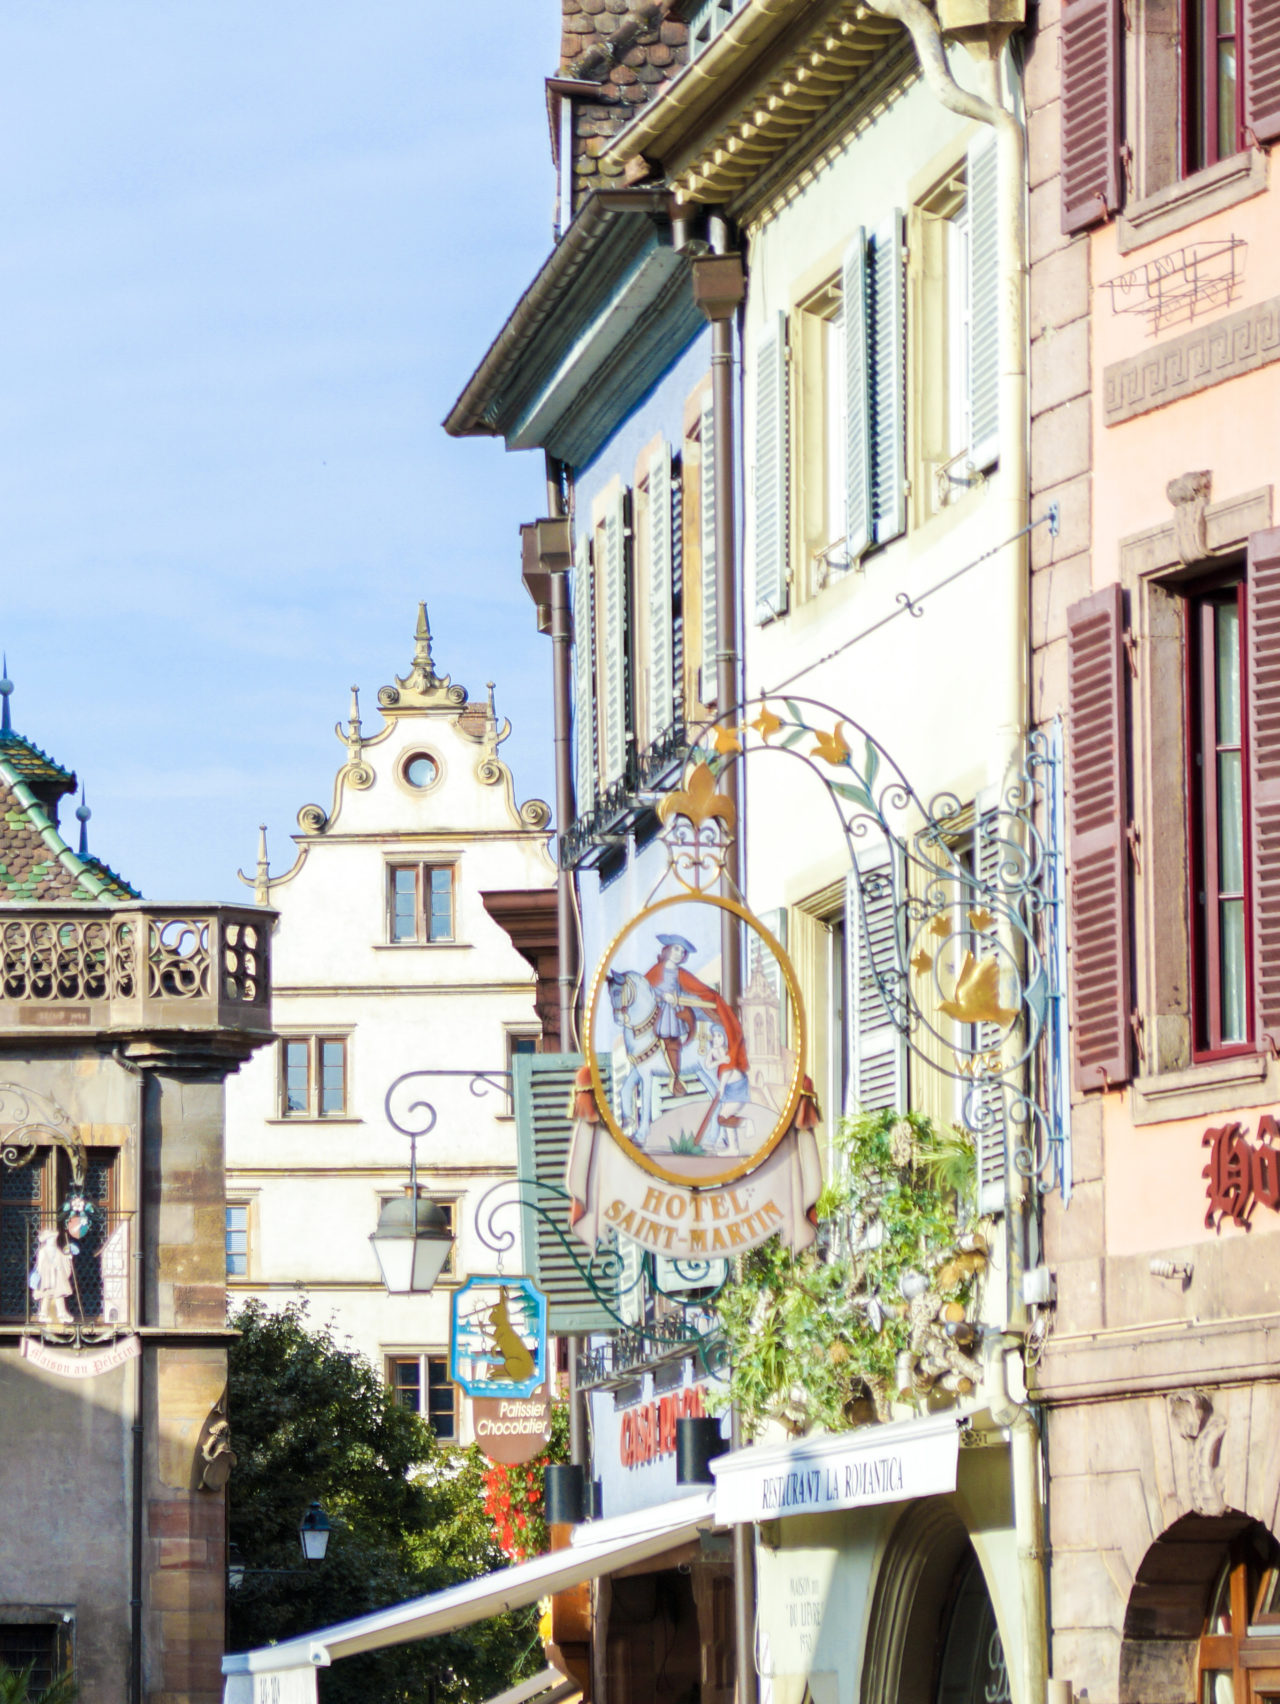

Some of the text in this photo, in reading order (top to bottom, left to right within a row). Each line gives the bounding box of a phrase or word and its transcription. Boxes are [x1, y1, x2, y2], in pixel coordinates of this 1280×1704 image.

[640, 1187, 749, 1222] HOTEL
[604, 1200, 785, 1253] SAINT-MARTIN
[30, 1347, 70, 1373] Maison
[477, 1418, 548, 1435] Chocolatier
[826, 1468, 840, 1501] LA
